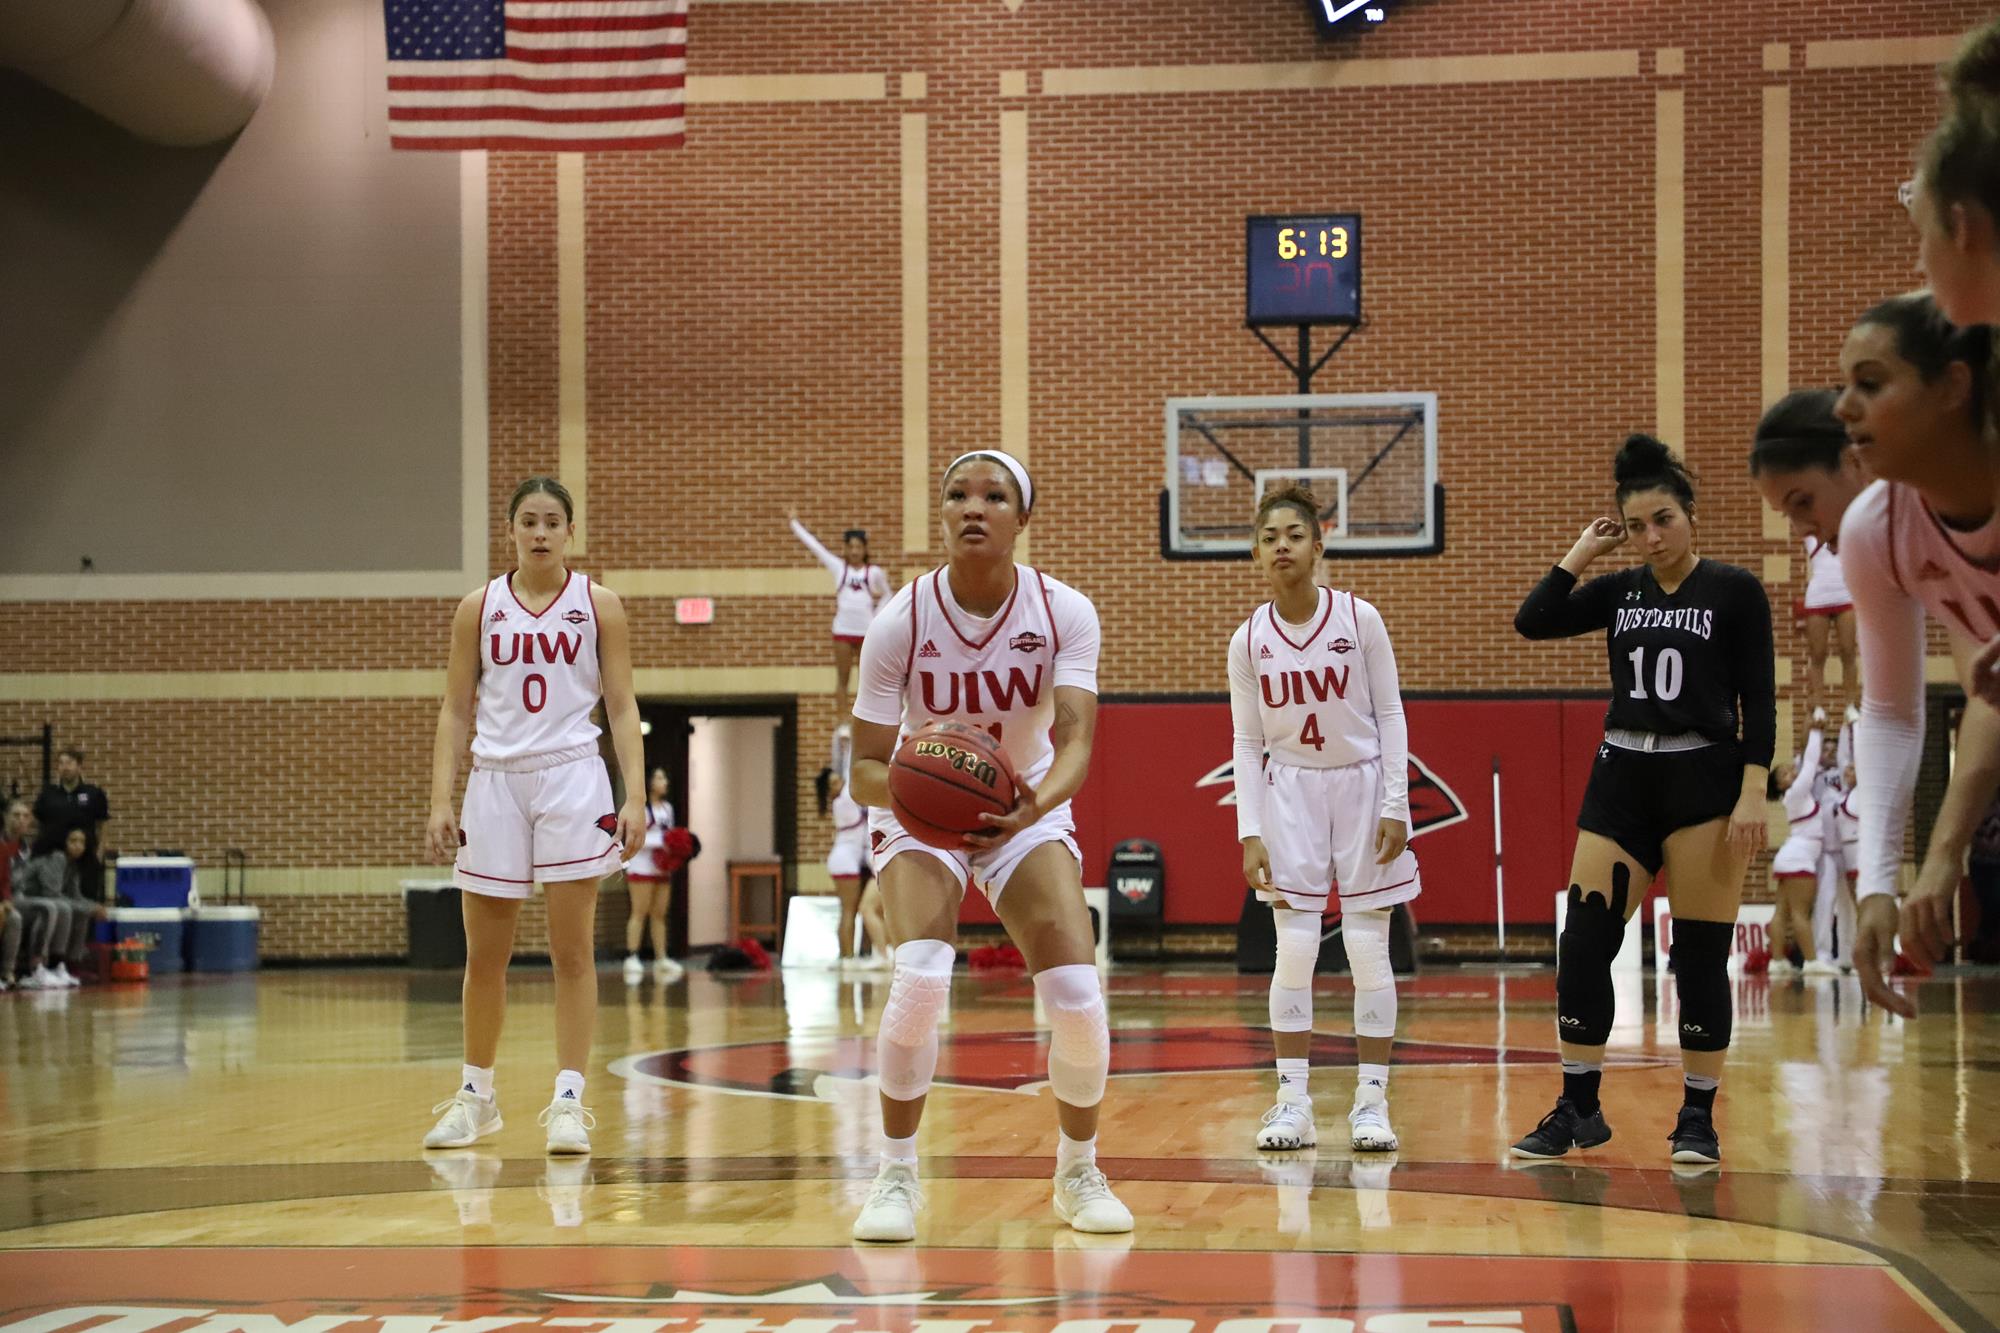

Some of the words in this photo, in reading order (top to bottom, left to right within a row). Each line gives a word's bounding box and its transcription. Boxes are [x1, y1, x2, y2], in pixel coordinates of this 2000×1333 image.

[1278, 226, 1348, 259] 6:13
[1614, 607, 1713, 641] DUSTDEVILS
[490, 631, 582, 666] UIW
[522, 673, 547, 713] 0
[918, 664, 1043, 715] UIW
[1260, 665, 1350, 708] UIW
[1628, 646, 1684, 701] 10
[1300, 713, 1325, 752] 4
[916, 741, 998, 790] Wilson
